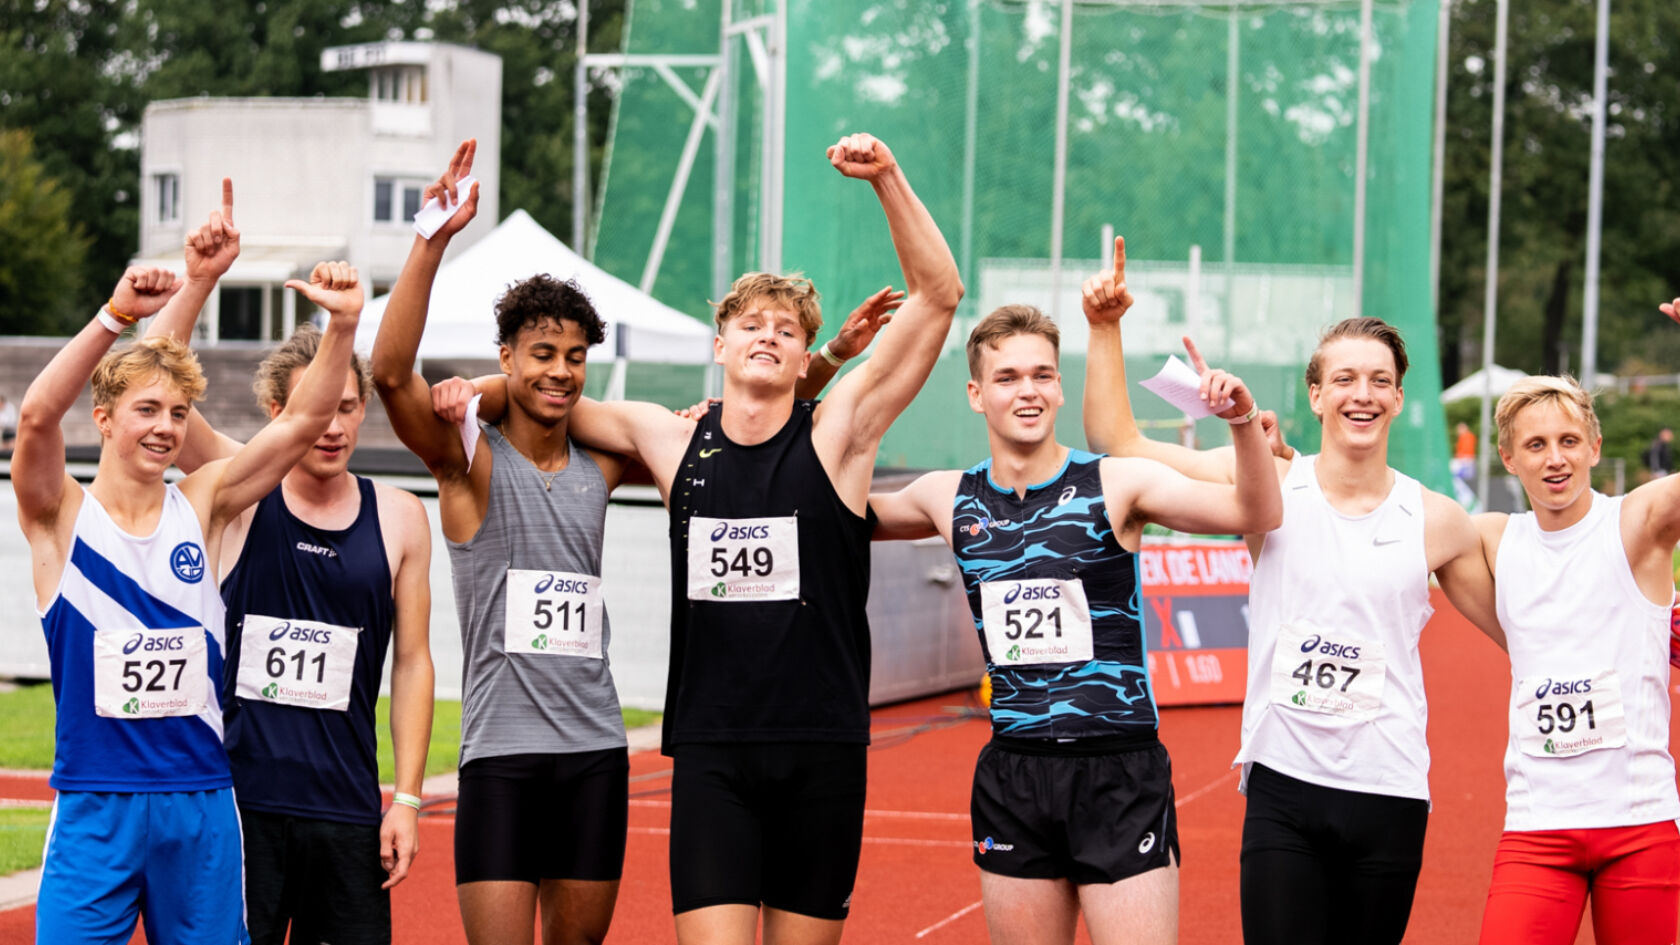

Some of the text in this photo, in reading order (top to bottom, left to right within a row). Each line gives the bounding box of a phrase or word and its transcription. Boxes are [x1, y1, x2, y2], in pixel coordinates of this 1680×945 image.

[728, 525, 769, 540] asics
[296, 541, 329, 556] CRAFT
[711, 547, 773, 577] 549
[1165, 550, 1199, 585] DE
[554, 579, 588, 594] asics
[1022, 586, 1060, 600] asics
[533, 600, 585, 632] 511
[1005, 607, 1062, 640] 521
[144, 636, 183, 651] asics
[290, 627, 331, 644] asics
[1320, 641, 1361, 659] asics
[122, 659, 187, 692] 527
[266, 647, 326, 683] 611
[1292, 659, 1361, 692] 467
[1552, 679, 1591, 695] asics
[1537, 700, 1595, 734] 591
